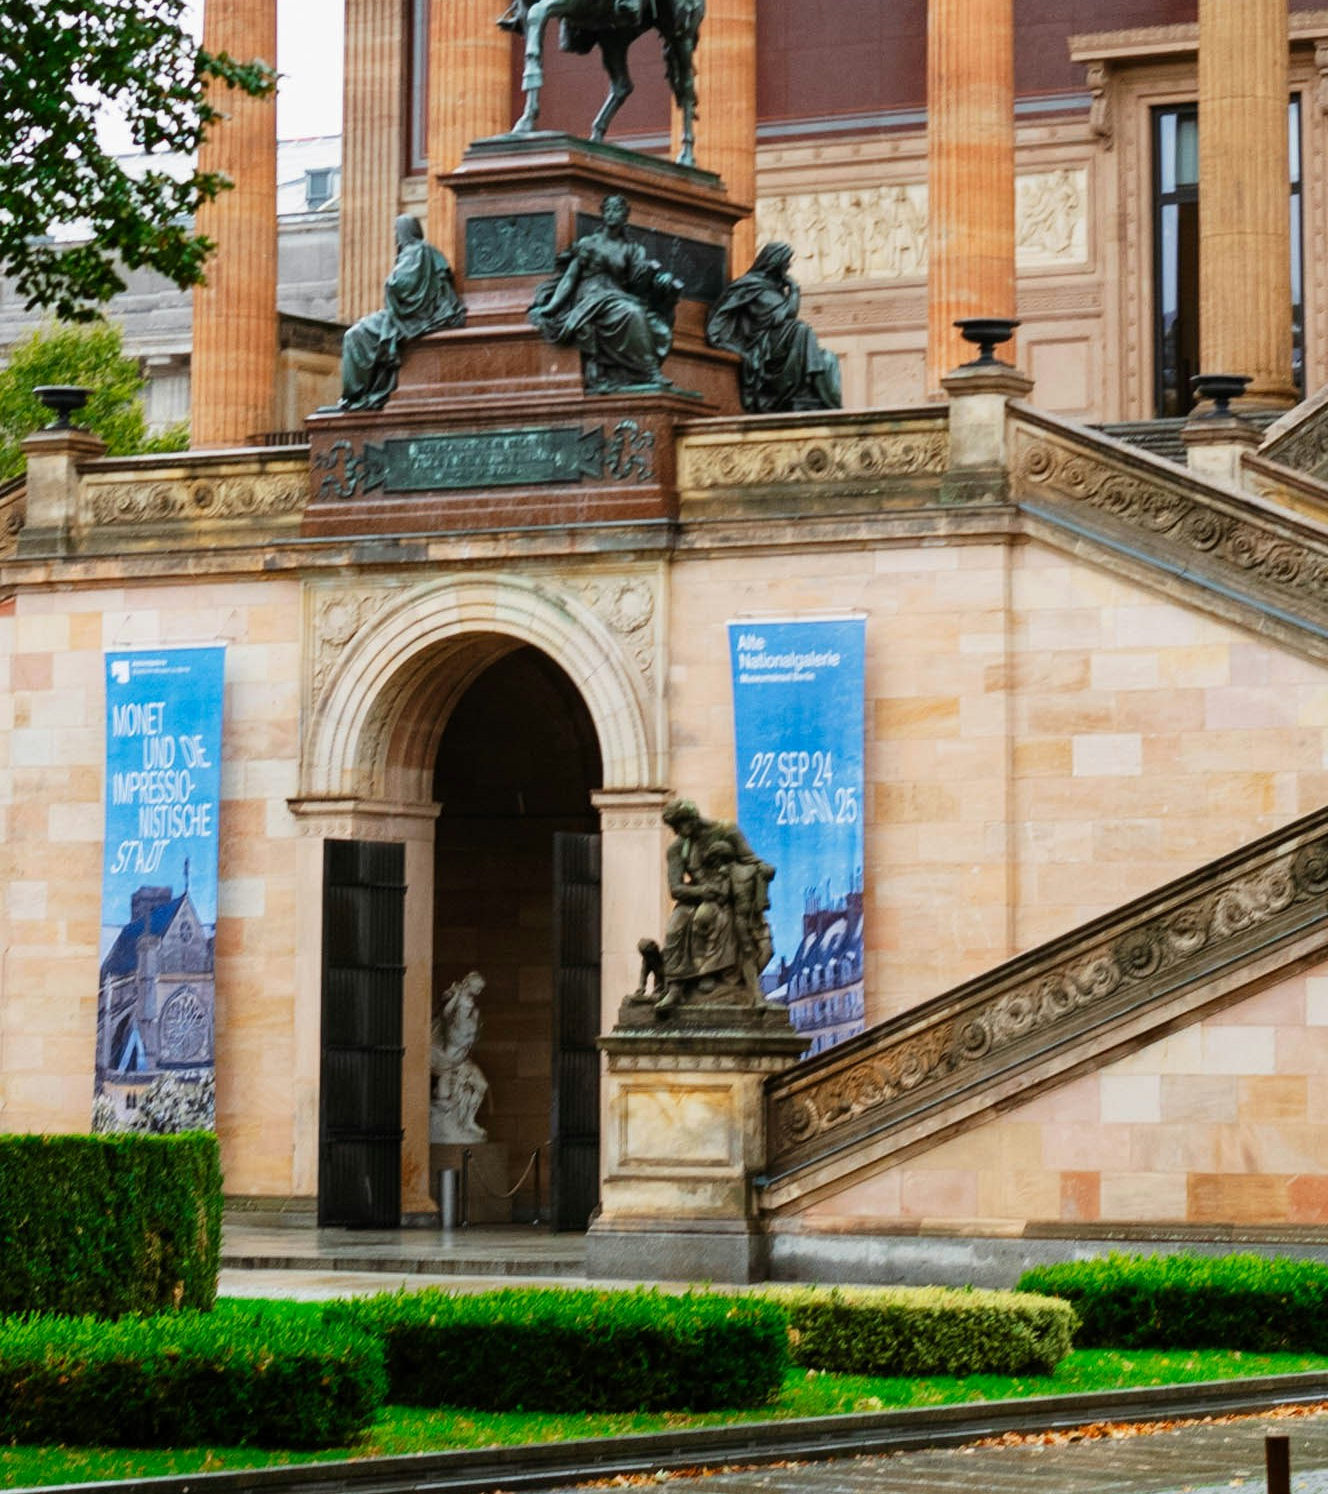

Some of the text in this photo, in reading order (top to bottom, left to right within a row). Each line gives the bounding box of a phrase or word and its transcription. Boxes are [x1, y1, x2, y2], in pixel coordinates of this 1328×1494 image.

[737, 633, 766, 651] Alte
[738, 650, 840, 673] Nationalgalerie
[113, 702, 167, 737] MONET
[143, 734, 212, 770] UND DIE
[745, 750, 833, 788] 27. SEP 24
[112, 769, 196, 806] IMPRESSIO-
[139, 803, 213, 839] NISTISCHE
[775, 787, 858, 825] 26. JAN 25
[110, 839, 171, 874] STADT
